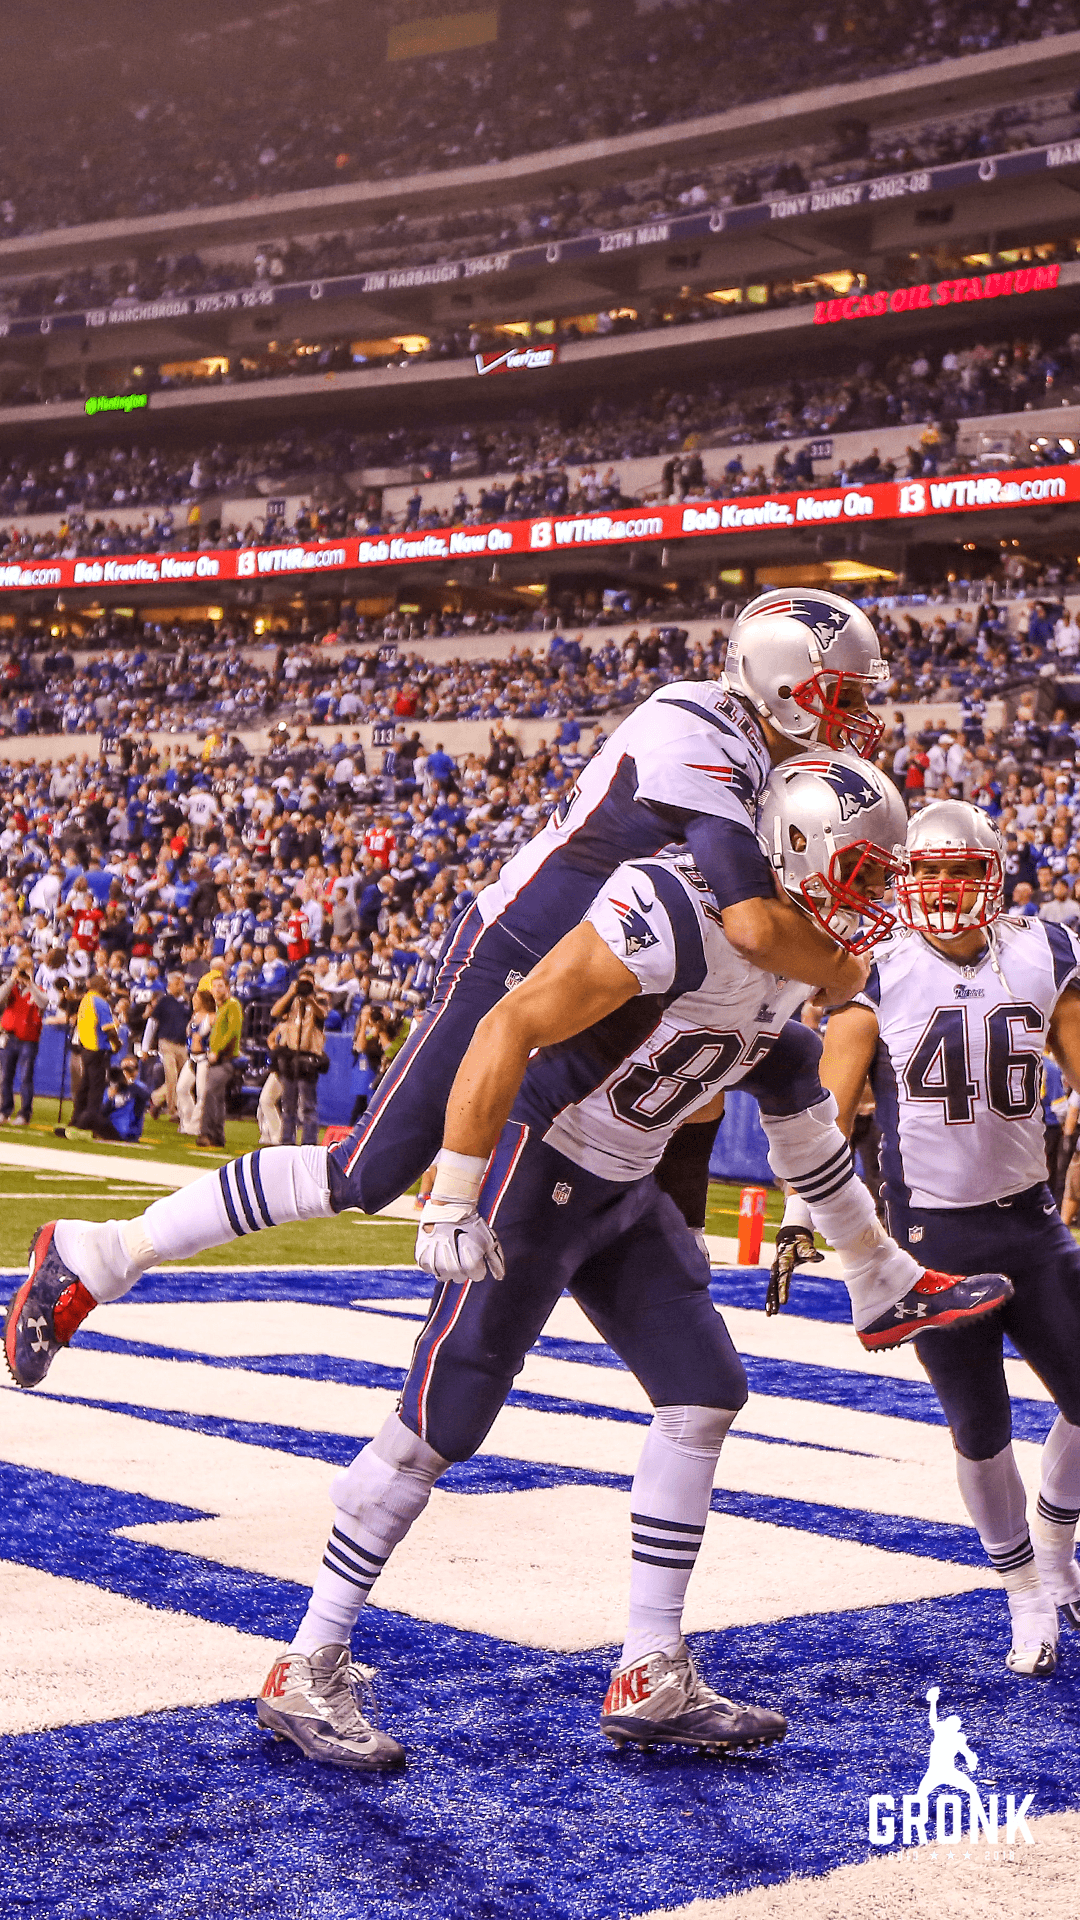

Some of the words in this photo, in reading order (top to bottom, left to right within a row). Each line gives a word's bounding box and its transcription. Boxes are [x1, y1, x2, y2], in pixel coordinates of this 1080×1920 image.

[769, 201, 808, 219] TONY
[811, 189, 861, 211] DUNGY
[868, 174, 931, 201] 2002-08
[599, 231, 634, 252] 12TH
[636, 224, 669, 245] MAN
[362, 275, 386, 292] JIM
[389, 265, 459, 289] HARBAUGH
[812, 291, 889, 325] LUCAS
[890, 284, 933, 313] OIL
[935, 264, 1060, 306] STADIUM
[86, 310, 105, 327] TED
[506, 349, 555, 369] verizon
[682, 507, 721, 532] Bob
[721, 501, 794, 526] Kravitz,
[796, 497, 843, 521] Now
[843, 492, 873, 516] On
[899, 484, 925, 513] 13
[358, 539, 389, 563] Bob
[389, 534, 449, 561] Kravitz,
[450, 532, 487, 554] Now
[487, 529, 512, 551] On
[530, 522, 551, 548] 13
[74, 562, 103, 584] Bob
[103, 558, 160, 581] Kravitz,
[160, 557, 197, 578] Now
[196, 556, 220, 576] On
[237, 551, 256, 576] 13
[373, 728, 394, 744] 113
[902, 1001, 1044, 1126] 46
